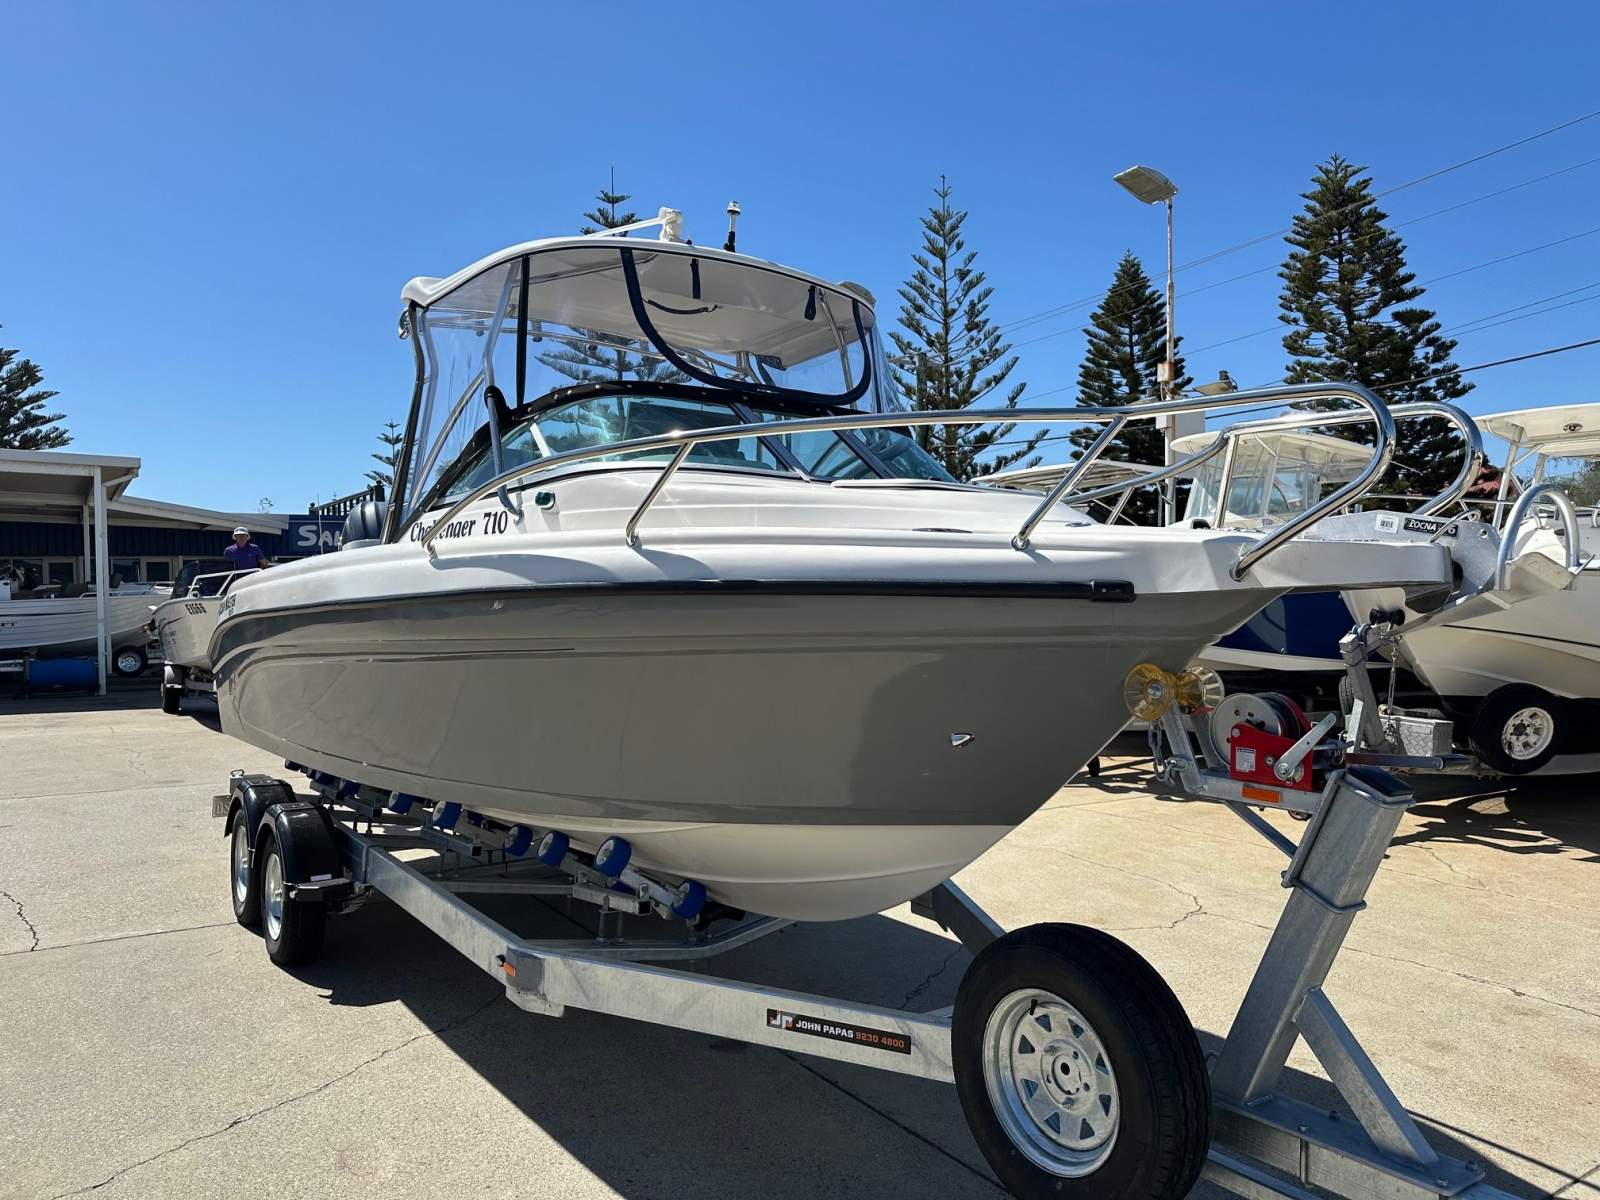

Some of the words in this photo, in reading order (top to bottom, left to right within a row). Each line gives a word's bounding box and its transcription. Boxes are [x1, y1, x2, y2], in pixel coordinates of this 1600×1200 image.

[410, 519, 476, 542] Chaenger
[483, 510, 508, 535] 710
[795, 1019, 821, 1032] JOHN
[823, 1025, 854, 1039] PAPAS
[855, 1031, 879, 1043] 9230
[880, 1037, 905, 1049] 4800
